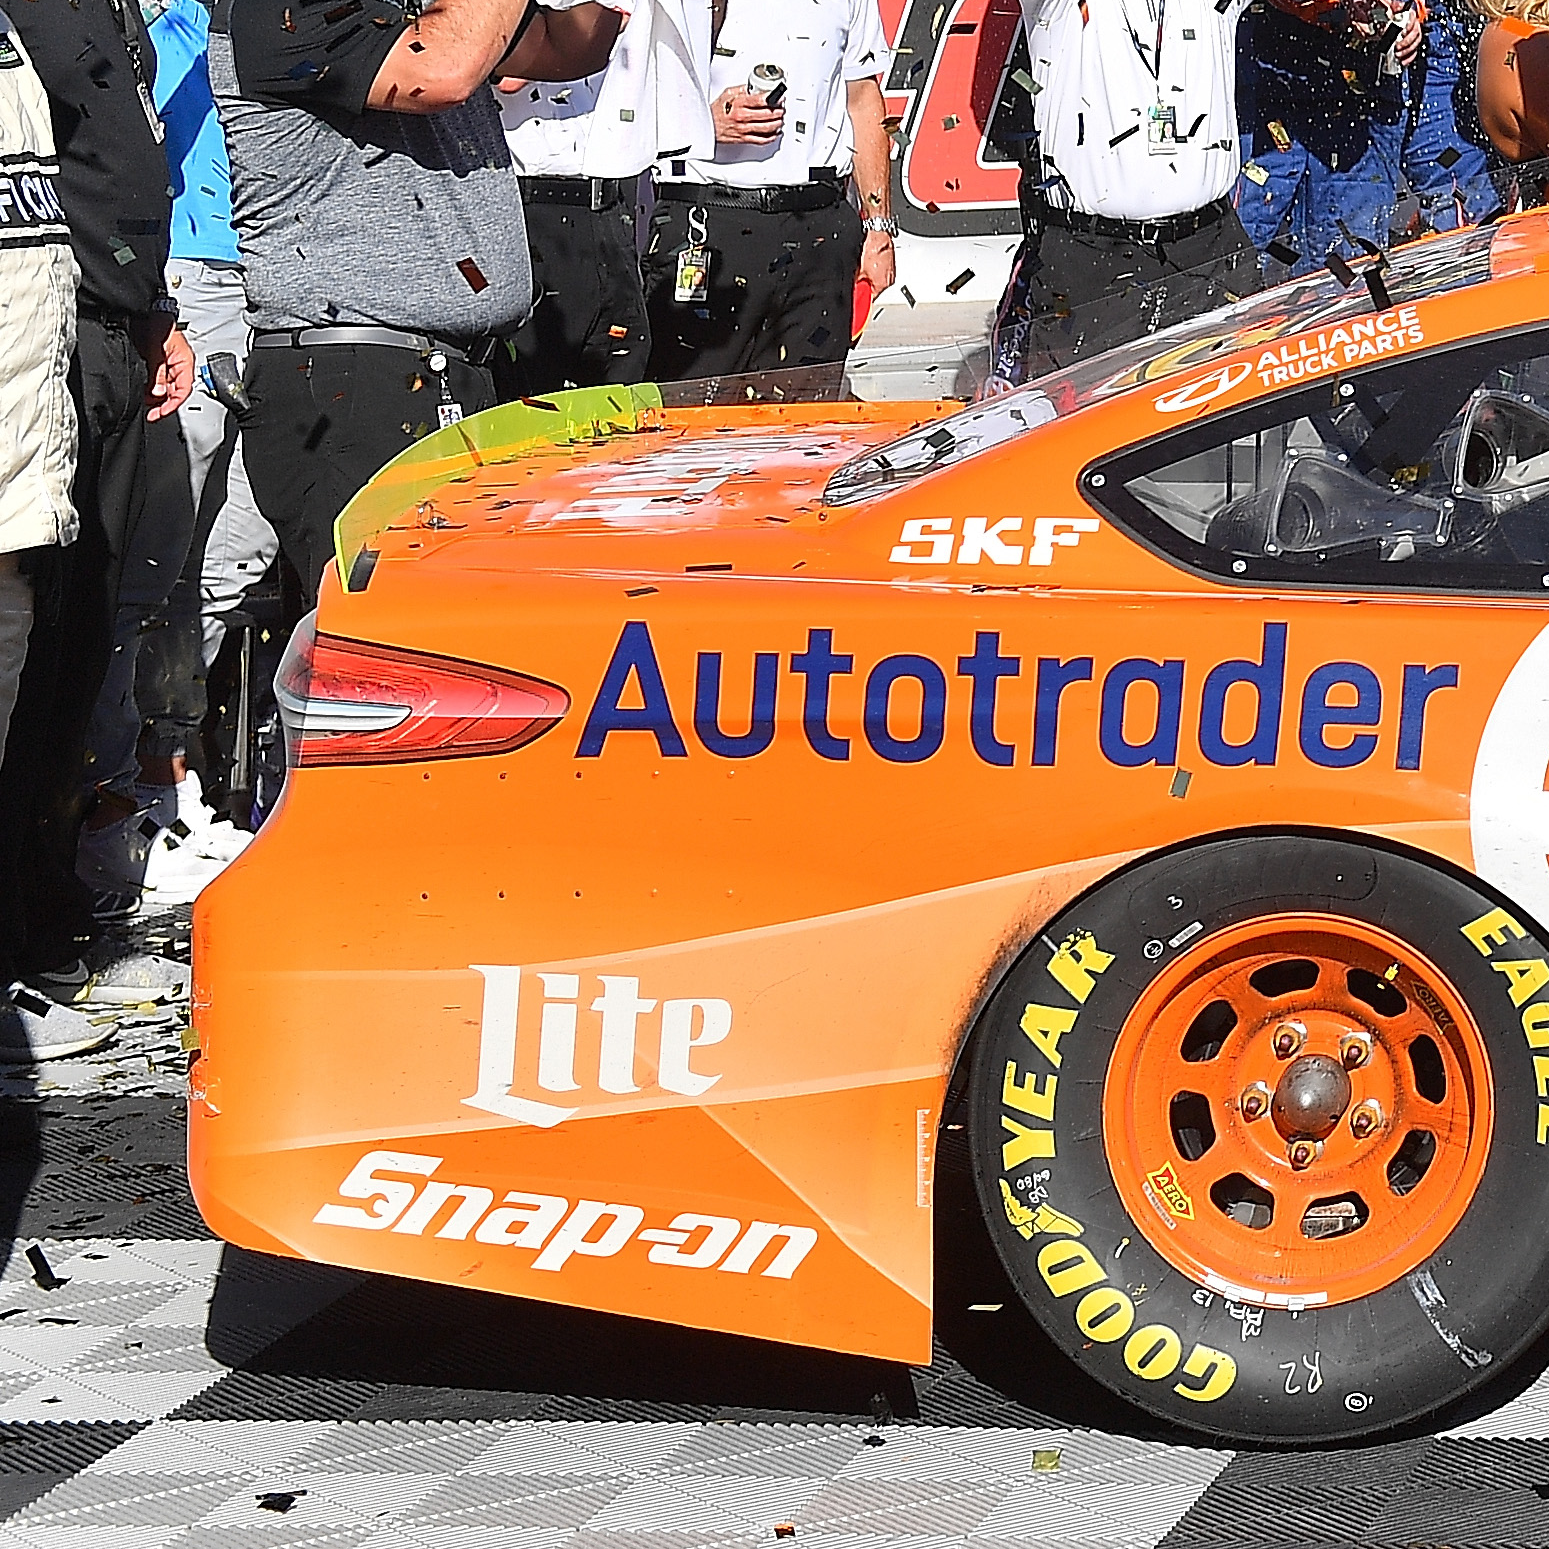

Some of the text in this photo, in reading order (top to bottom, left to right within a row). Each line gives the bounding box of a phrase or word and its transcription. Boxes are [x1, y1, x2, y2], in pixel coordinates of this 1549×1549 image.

[1256, 305, 1420, 372] ALLIANCE
[1258, 323, 1426, 389] TRUCK PARTS
[889, 516, 1100, 566] SKF
[577, 621, 1459, 769] Autotrader
[460, 963, 734, 1129] Lite
[312, 1149, 819, 1280] Snap-on
[1157, 1173, 1187, 1214] AERO
